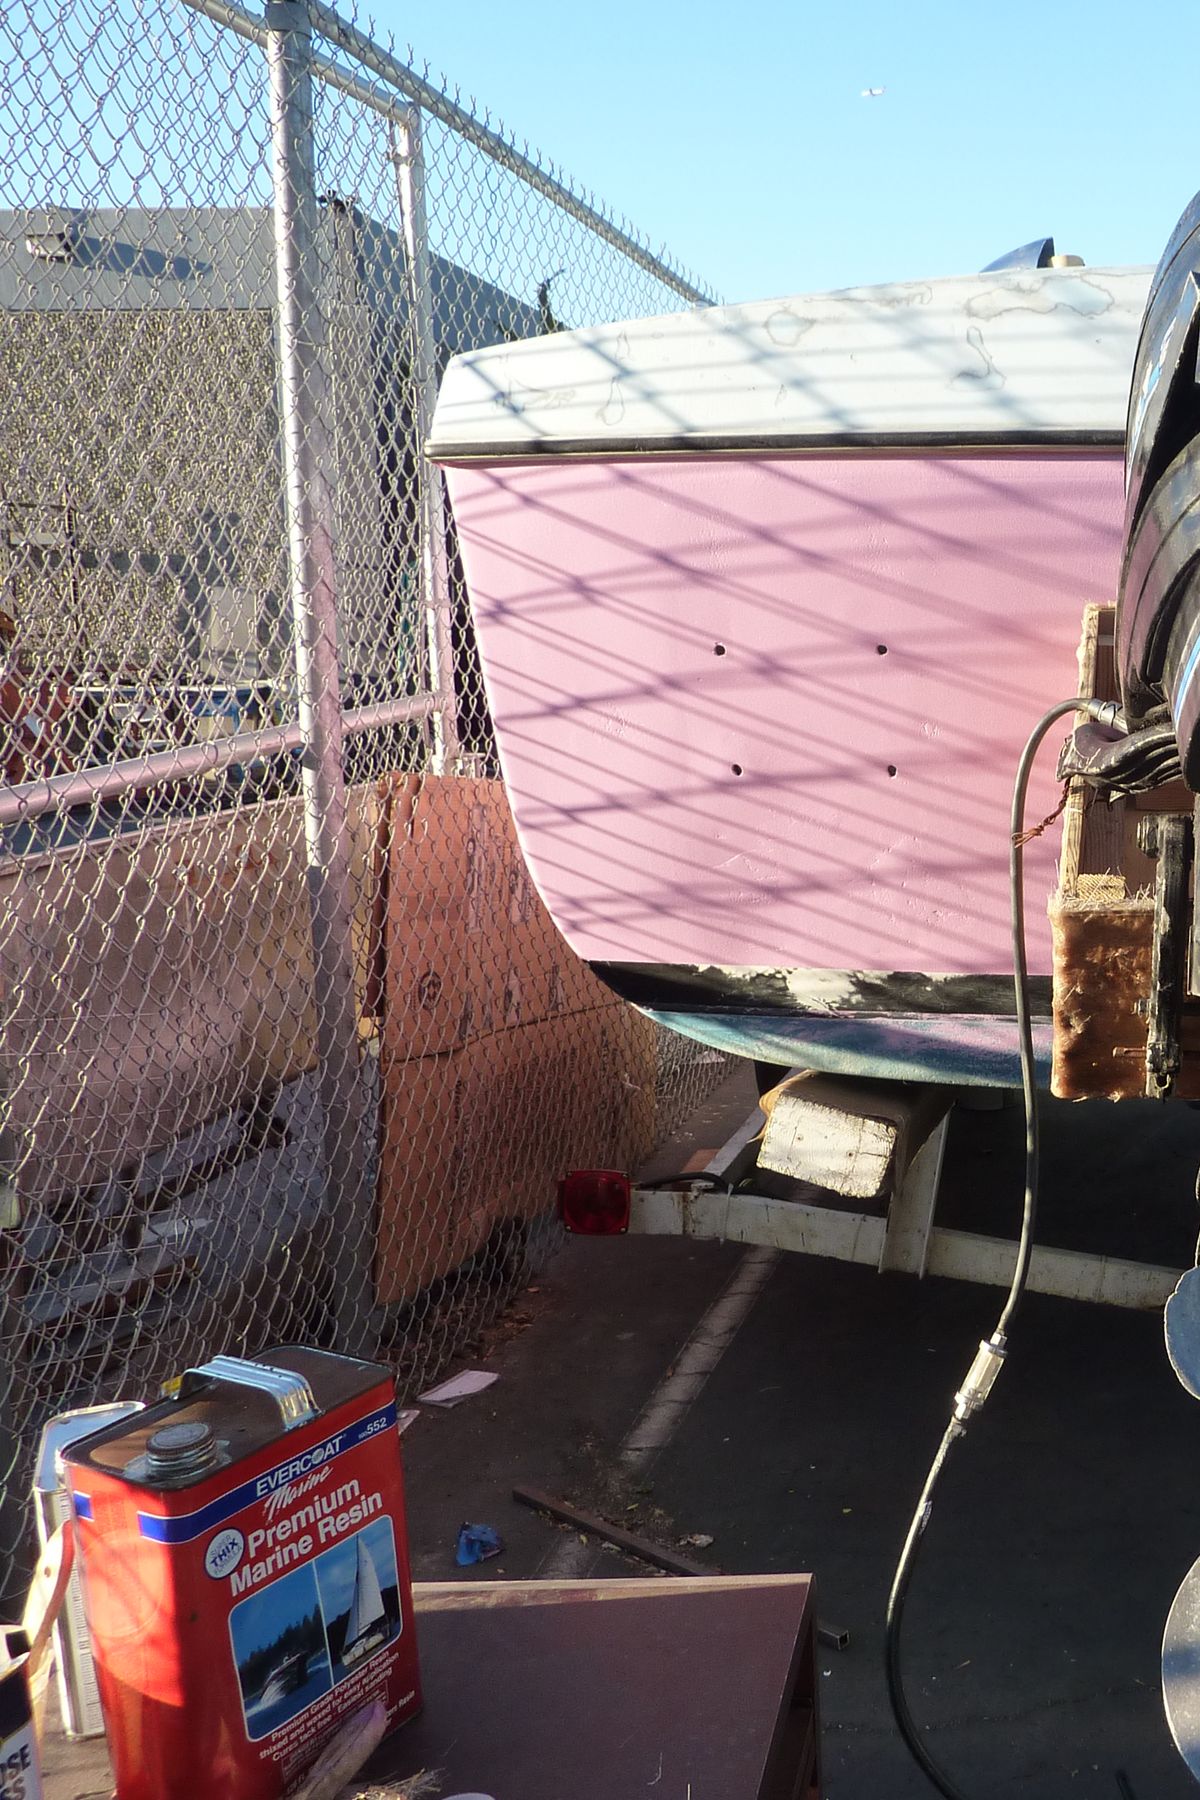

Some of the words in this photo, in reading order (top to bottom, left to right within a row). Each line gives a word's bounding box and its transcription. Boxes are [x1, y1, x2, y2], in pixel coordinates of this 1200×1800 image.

[256, 1435, 344, 1498] EVERCOAT
[229, 1534, 314, 1597] Marine
[317, 1492, 383, 1543] Resin
[248, 1479, 360, 1559] Premium
[209, 1538, 239, 1568] THIX
[271, 1712, 309, 1742] Premium
[310, 1690, 334, 1714] Grade
[289, 1722, 305, 1738] and
[332, 1696, 342, 1709] for
